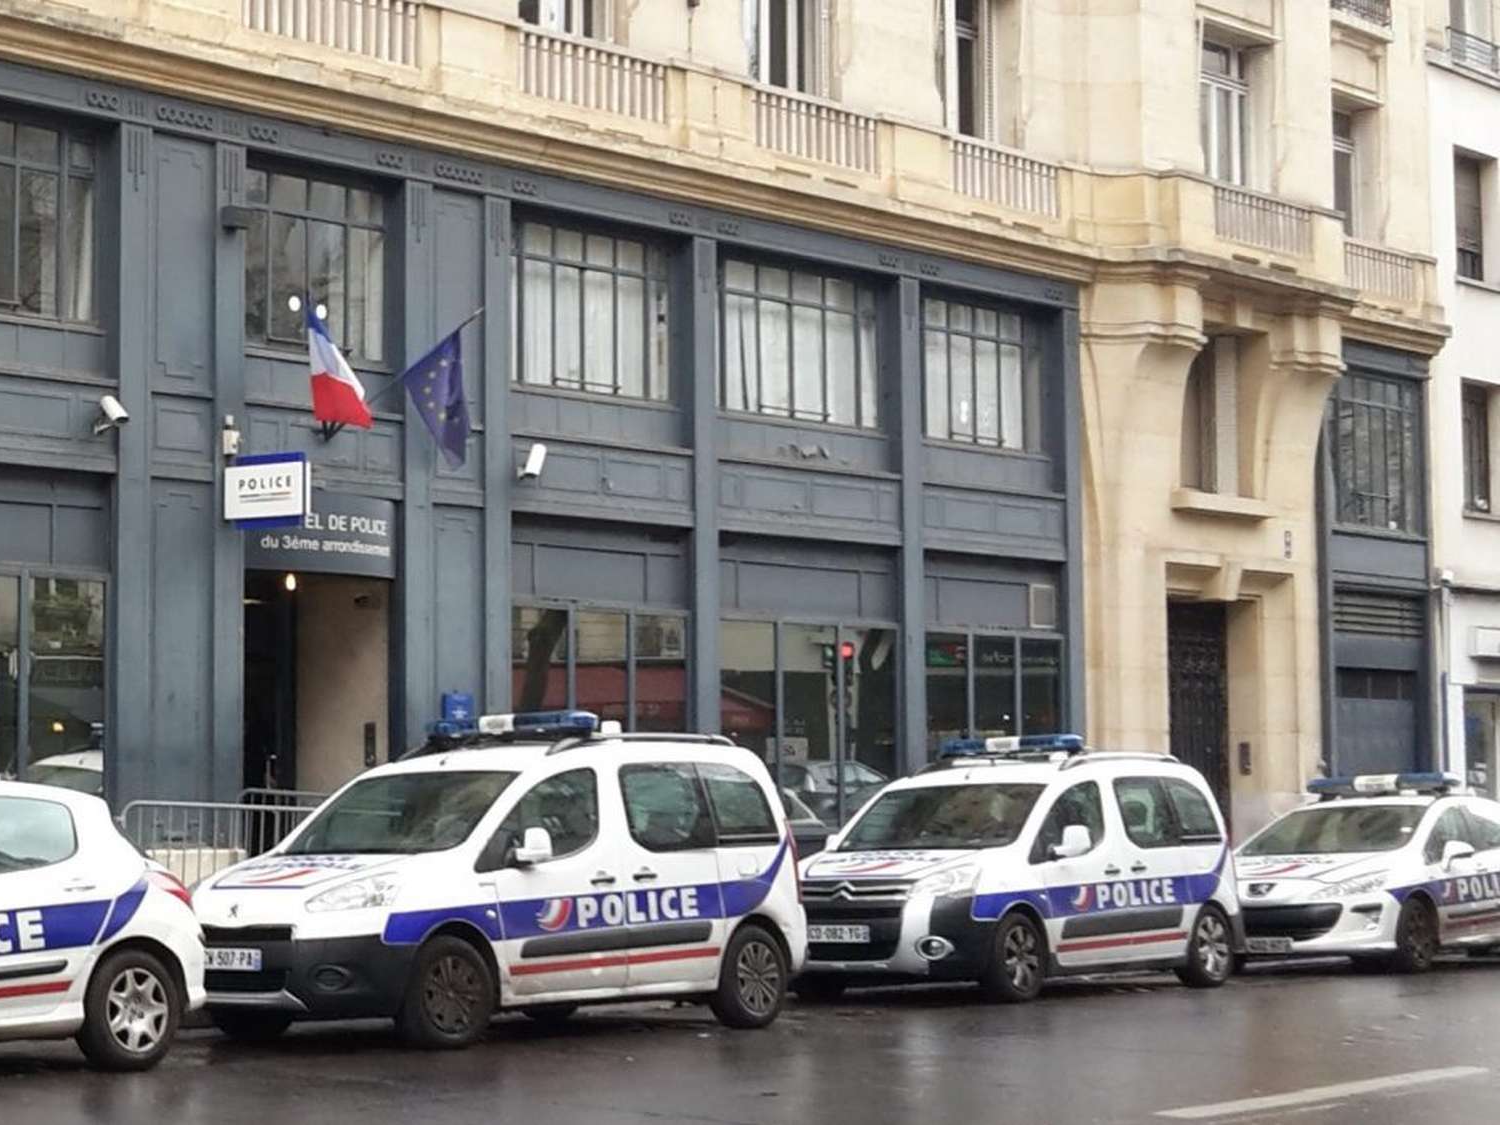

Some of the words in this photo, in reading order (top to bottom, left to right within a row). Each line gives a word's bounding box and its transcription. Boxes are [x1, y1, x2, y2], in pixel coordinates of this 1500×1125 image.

[238, 475, 292, 490] POLICE
[328, 513, 348, 532] DE
[351, 516, 388, 536] POLICE
[261, 535, 280, 548] du
[1096, 879, 1176, 909] POLICE
[1456, 872, 1500, 901] POLI
[576, 887, 699, 928] POLICE
